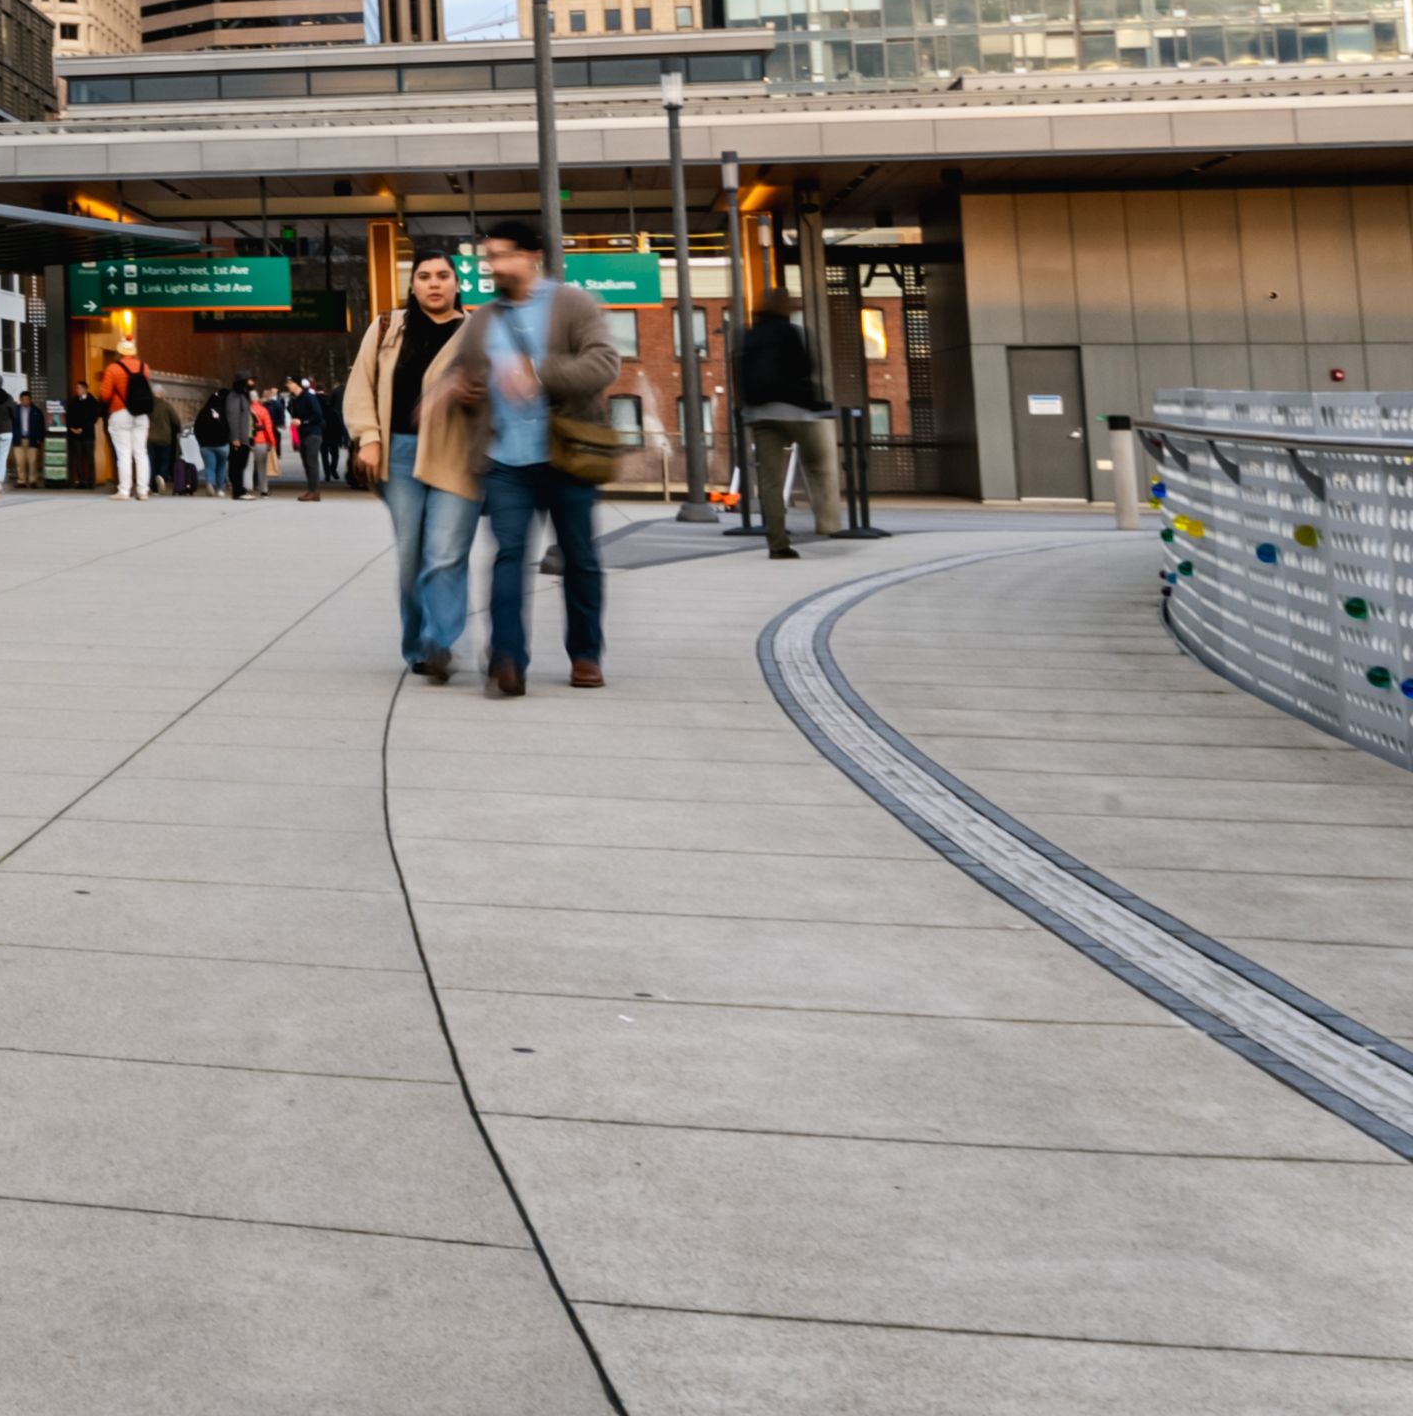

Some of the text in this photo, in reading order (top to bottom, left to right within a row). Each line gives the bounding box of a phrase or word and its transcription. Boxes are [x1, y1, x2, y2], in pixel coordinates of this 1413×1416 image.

[141, 265, 250, 276] Marion Street, 1st Ave
[142, 283, 253, 295] Link Light Rail, 3rd Ave
[585, 279, 637, 290] Stadiums
